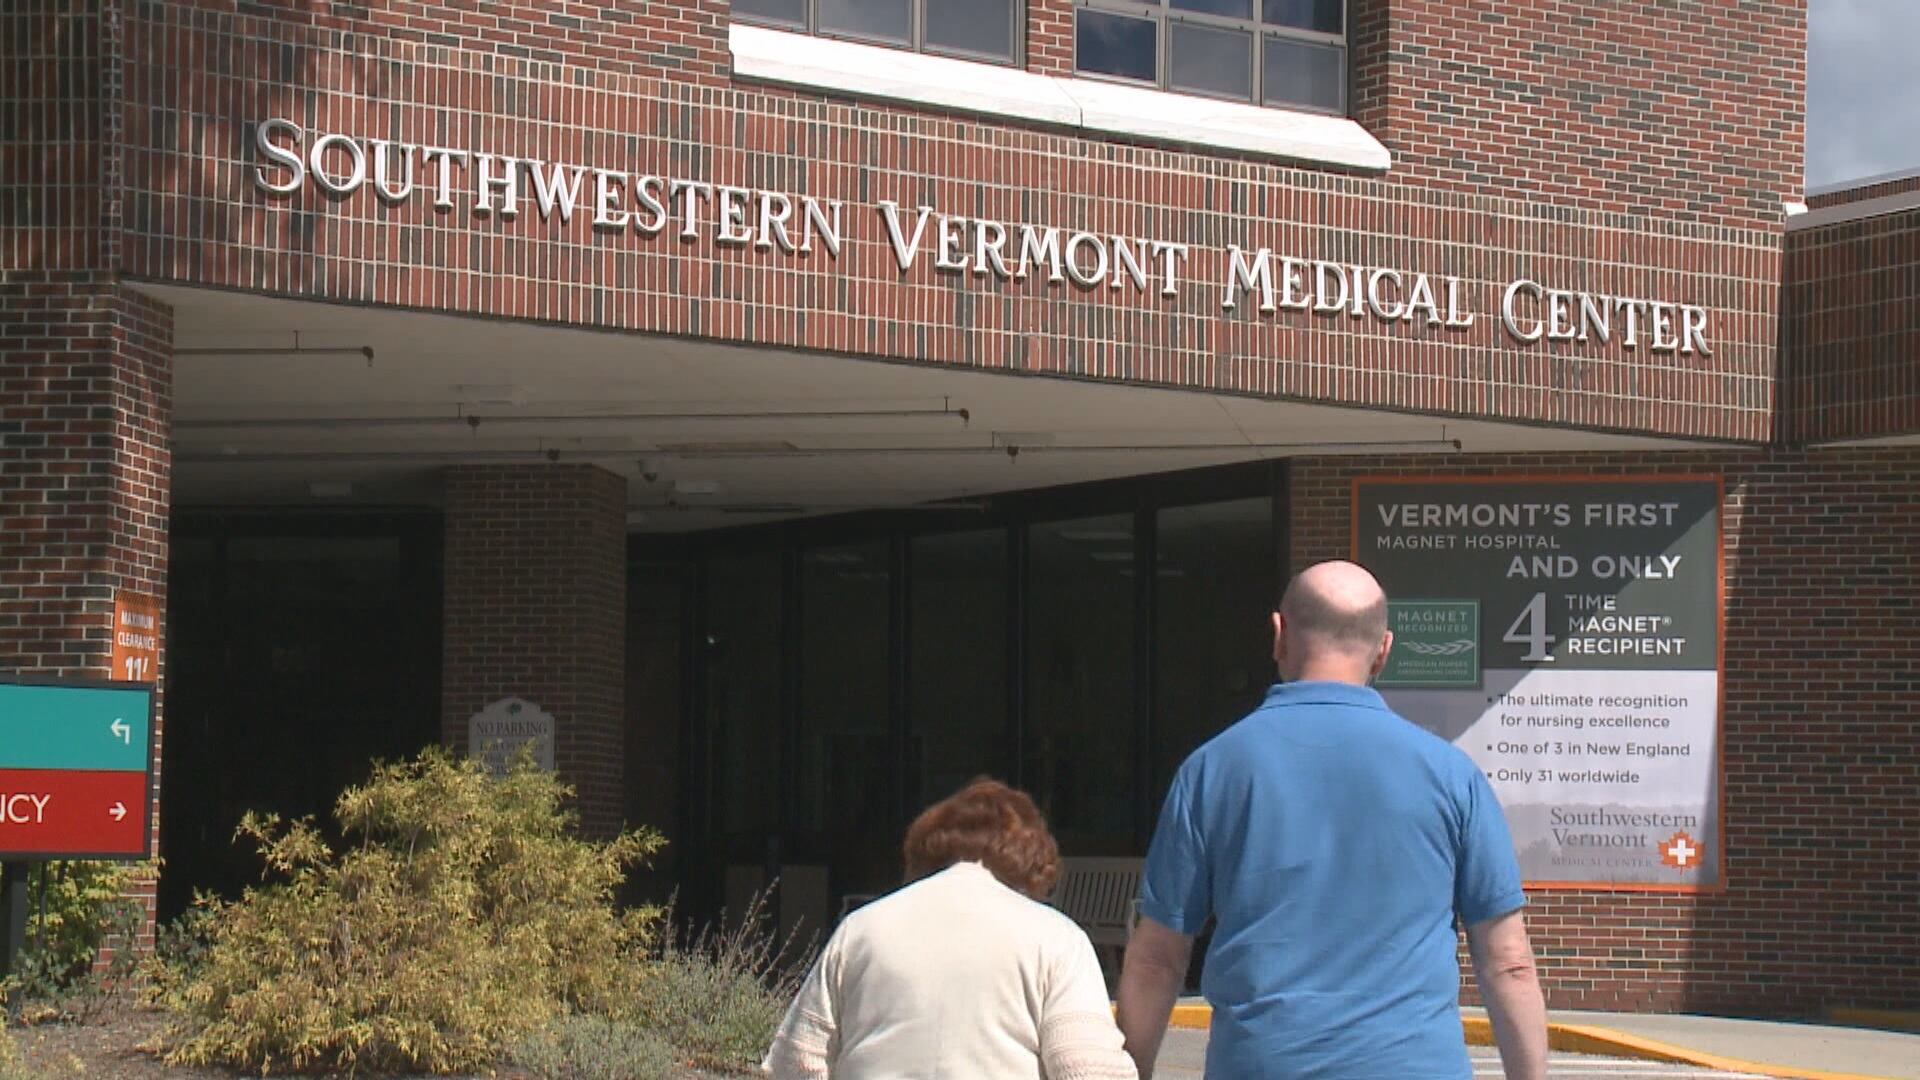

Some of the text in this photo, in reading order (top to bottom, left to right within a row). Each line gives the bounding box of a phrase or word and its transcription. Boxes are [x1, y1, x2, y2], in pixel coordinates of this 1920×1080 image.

[255, 118, 1712, 357] SOUTHWESTERN VERMONT MEDICAL CENTER
[1377, 504, 1679, 527] VERMONT'S FIRST
[1377, 535, 1560, 549] MAGNET HOSPITAL
[1506, 556, 1681, 579] AND ONLY
[1565, 594, 1617, 610] TIME
[1397, 611, 1468, 622] MAGNET
[1502, 592, 1556, 661] 4
[118, 631, 156, 651] CLEARANCE
[1568, 639, 1686, 655] RECIPIENT
[1500, 694, 1688, 709] The ultimate recognition
[476, 721, 547, 735] NO PARKING
[1500, 713, 1670, 729] for nursing excellence
[1497, 741, 1690, 757] One of 3 in New England
[1497, 768, 1640, 784] Only 31 worldwide
[1550, 808, 1697, 827] Southwestern
[1552, 828, 1647, 848] Vermont
